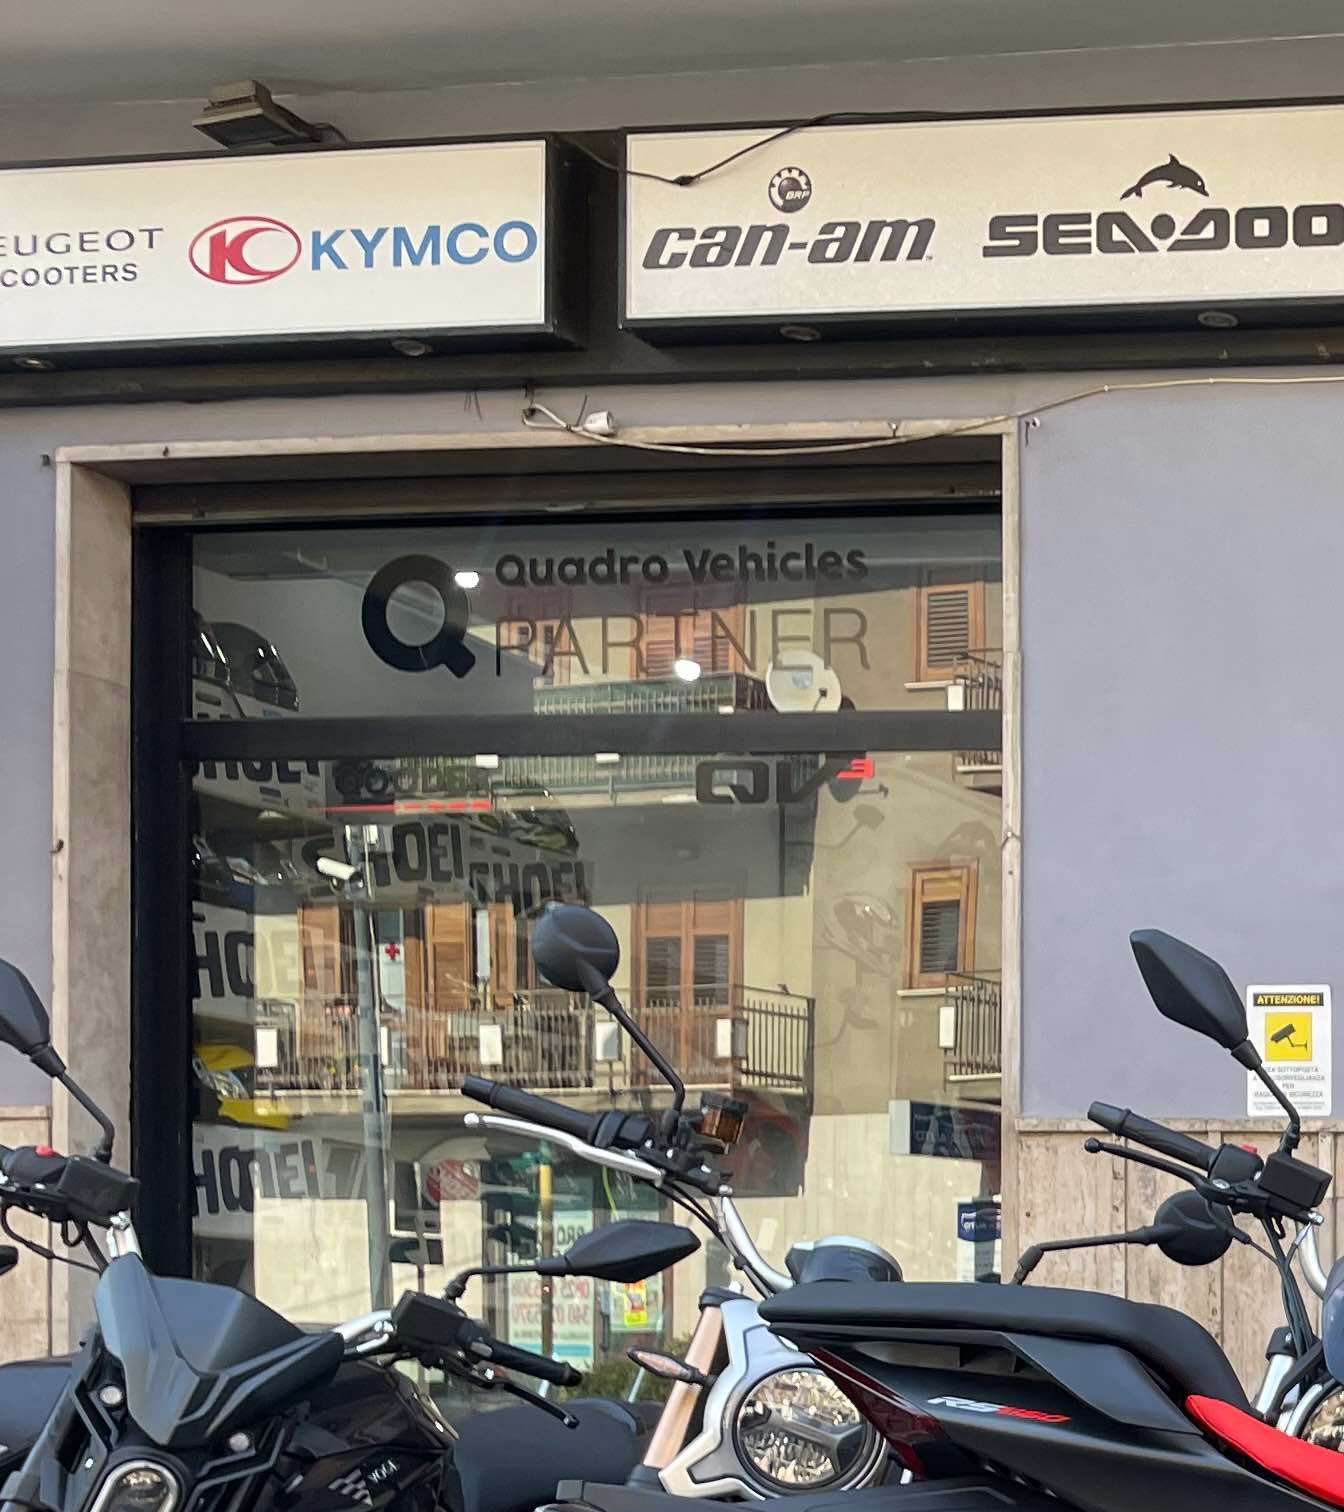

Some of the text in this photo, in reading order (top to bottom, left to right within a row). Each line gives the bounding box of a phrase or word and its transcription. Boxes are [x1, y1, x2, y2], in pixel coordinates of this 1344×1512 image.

[310, 219, 538, 272] KYMCO
[641, 215, 937, 270] can-am
[494, 541, 870, 588] Quadro Vehicles
[494, 607, 871, 679] PARTNER
[1256, 994, 1320, 1005] ATTENZIONE!
